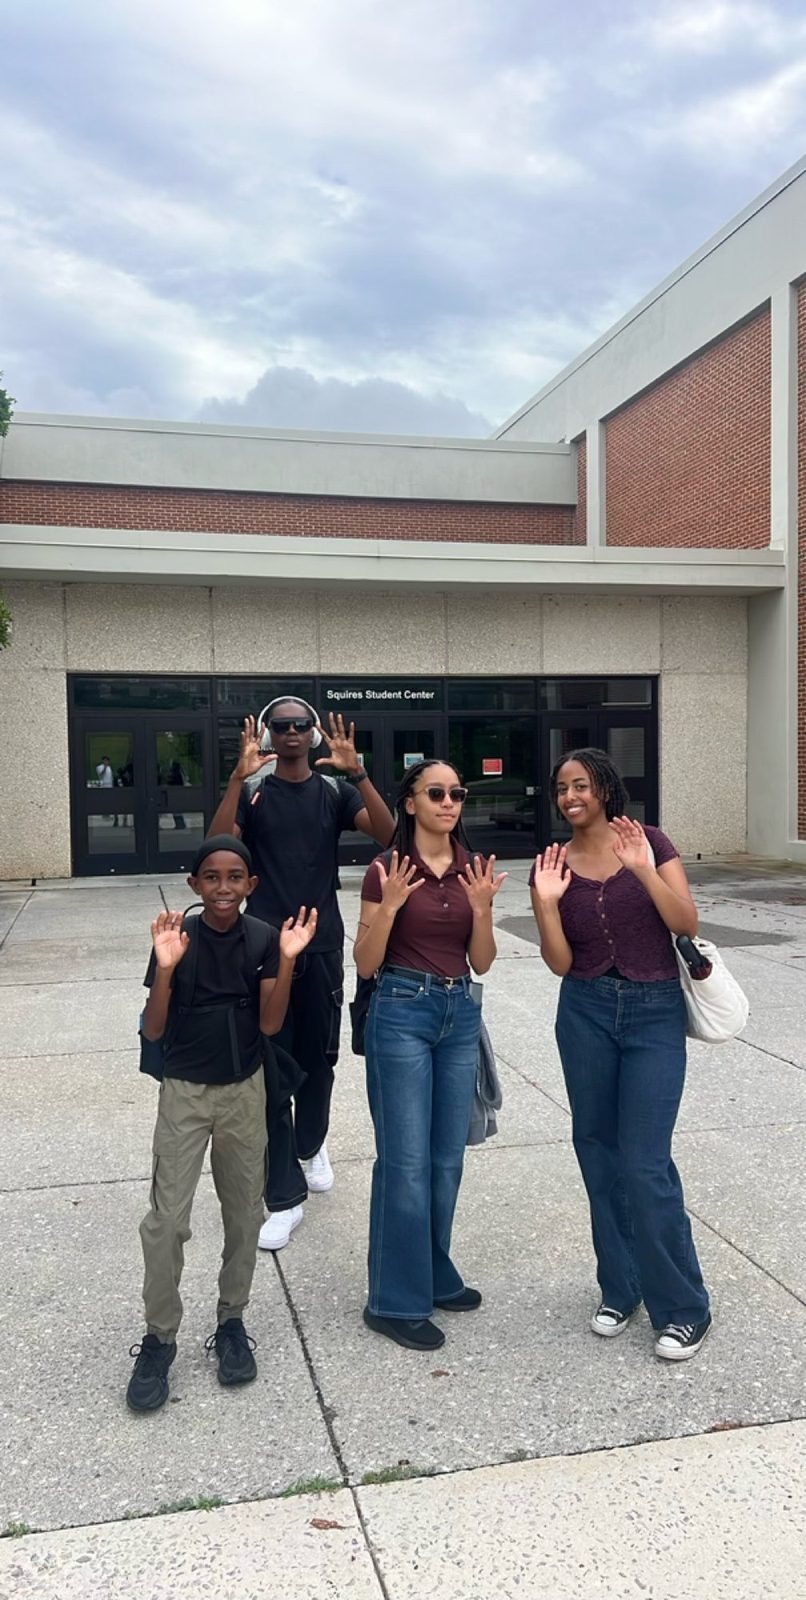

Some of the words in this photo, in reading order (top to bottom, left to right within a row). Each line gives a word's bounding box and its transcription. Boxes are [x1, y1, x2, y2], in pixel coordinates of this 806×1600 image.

[326, 690, 363, 701] Squires
[365, 690, 402, 699] Student
[403, 690, 435, 699] Center
